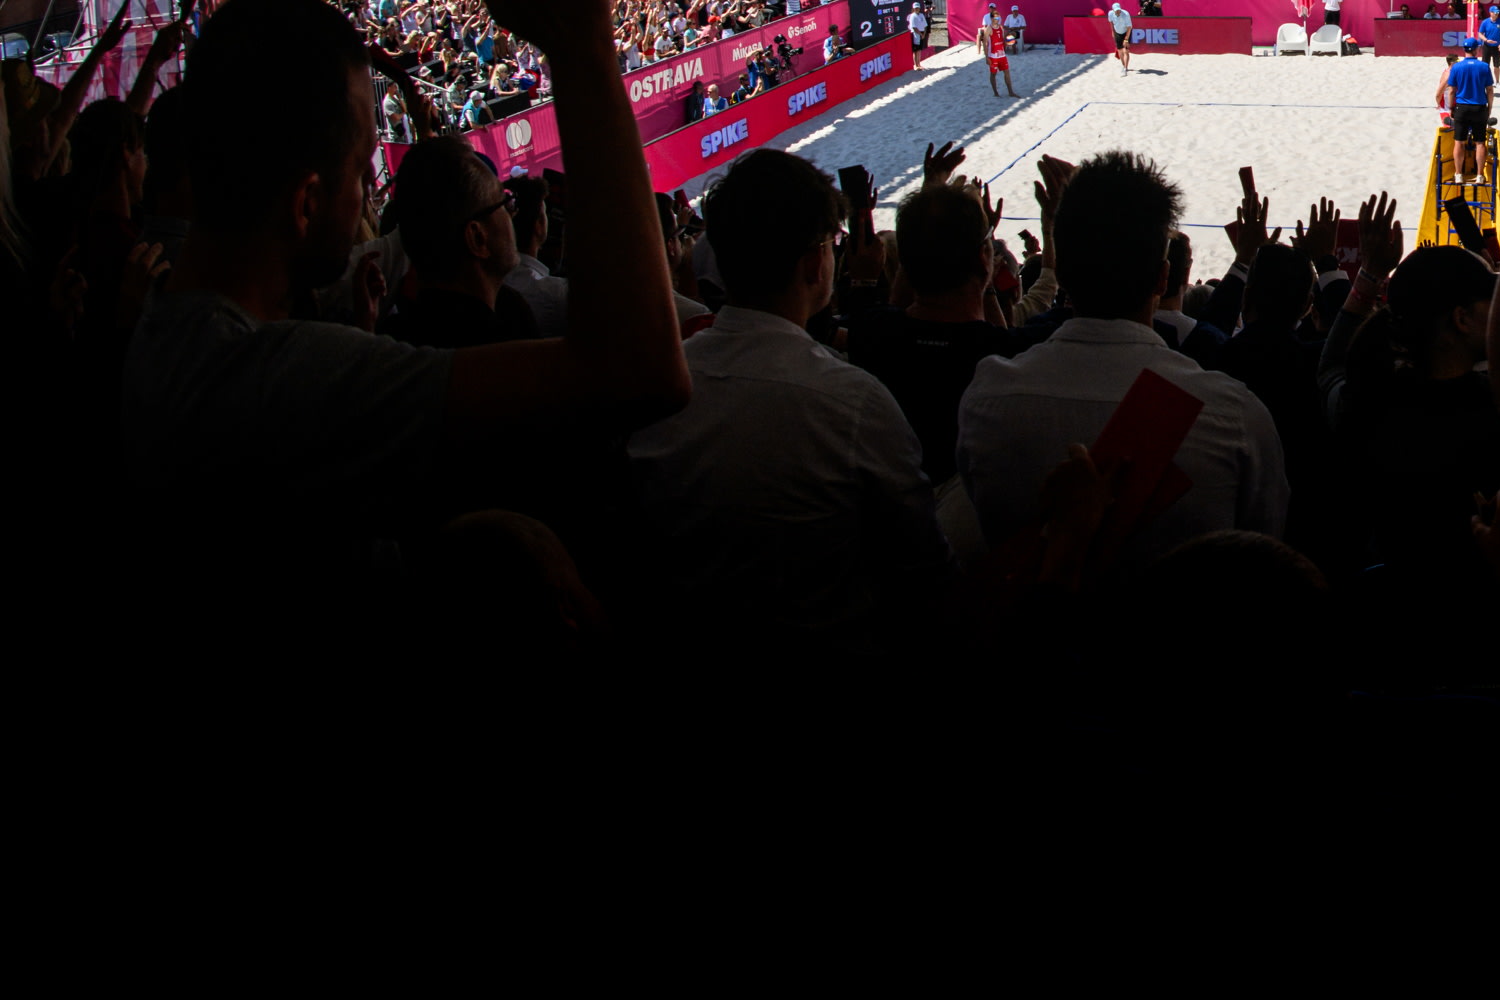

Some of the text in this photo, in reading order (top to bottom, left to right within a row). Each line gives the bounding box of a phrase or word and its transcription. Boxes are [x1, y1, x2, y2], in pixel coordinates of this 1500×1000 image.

[794, 20, 817, 36] Senoh
[861, 21, 873, 38] 2
[1132, 29, 1179, 45] PIKE
[629, 57, 704, 103] OSTRAVA
[859, 52, 892, 82] SPIKE
[788, 81, 827, 117] SPIKE
[701, 118, 748, 159] SPIKE
